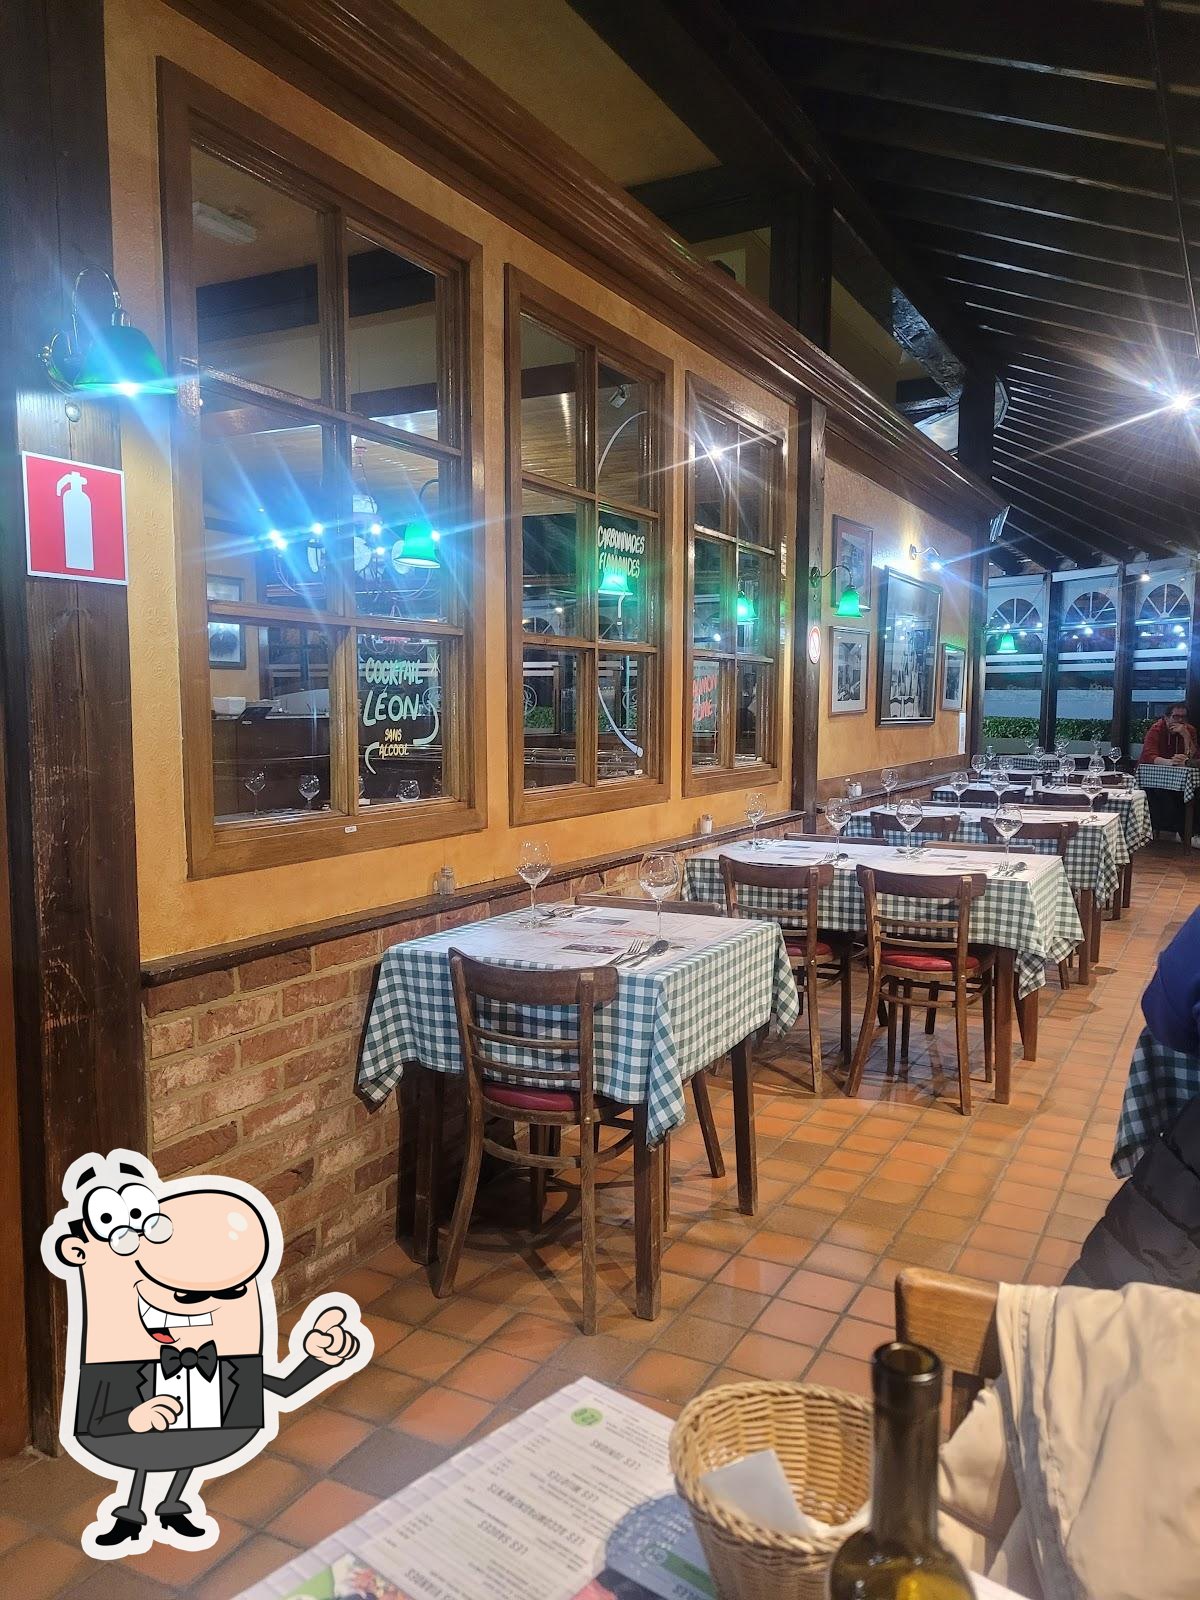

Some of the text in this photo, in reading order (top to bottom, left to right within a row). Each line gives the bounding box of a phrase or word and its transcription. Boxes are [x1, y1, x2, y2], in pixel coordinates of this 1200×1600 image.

[598, 526, 645, 554] CARBONNADES
[365, 657, 423, 686] COCKTAIL
[363, 685, 419, 726] LÉON
[384, 728, 402, 742] SANS
[378, 744, 409, 760] ALCOOL
